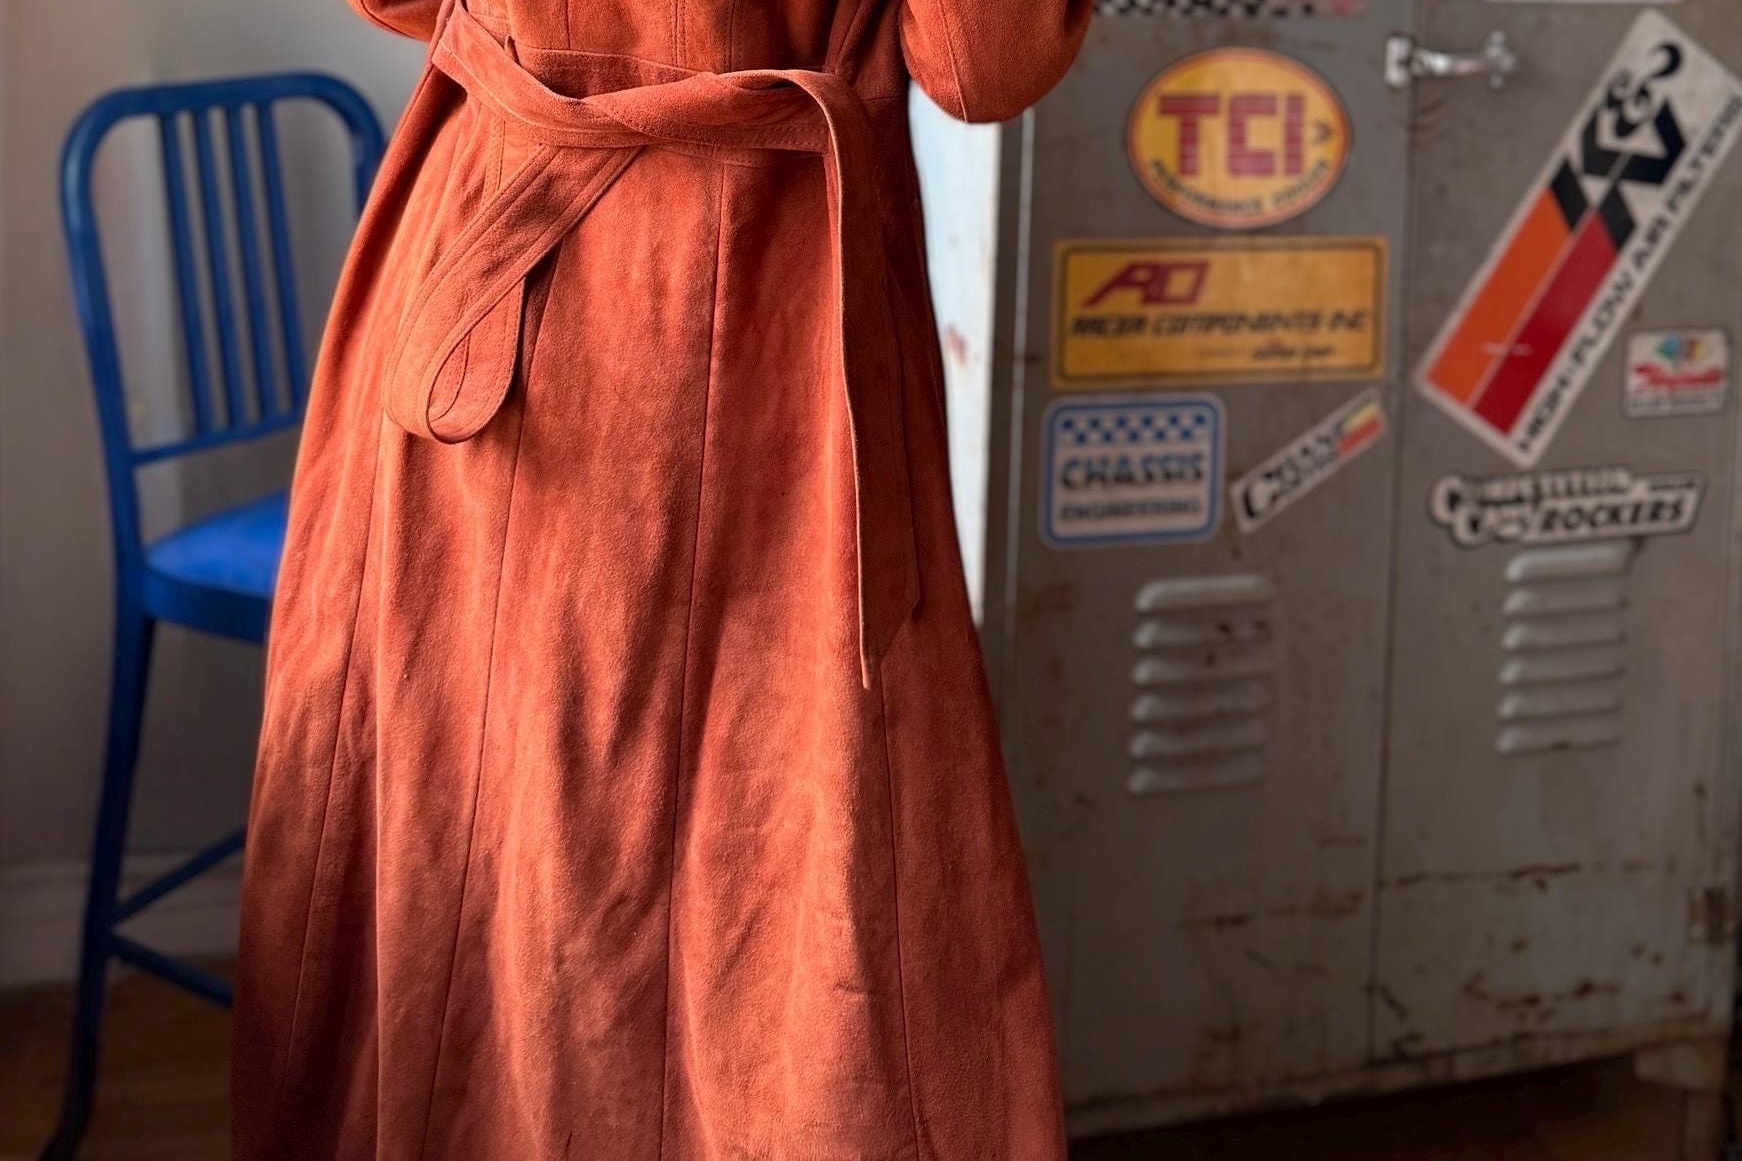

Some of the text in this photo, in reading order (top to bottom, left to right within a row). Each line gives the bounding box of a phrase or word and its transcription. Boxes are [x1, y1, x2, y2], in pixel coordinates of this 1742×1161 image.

[1156, 93, 1306, 177] TCI
[1060, 453, 1206, 490] CHASSIS
[1539, 498, 1686, 534] ROCKERS
